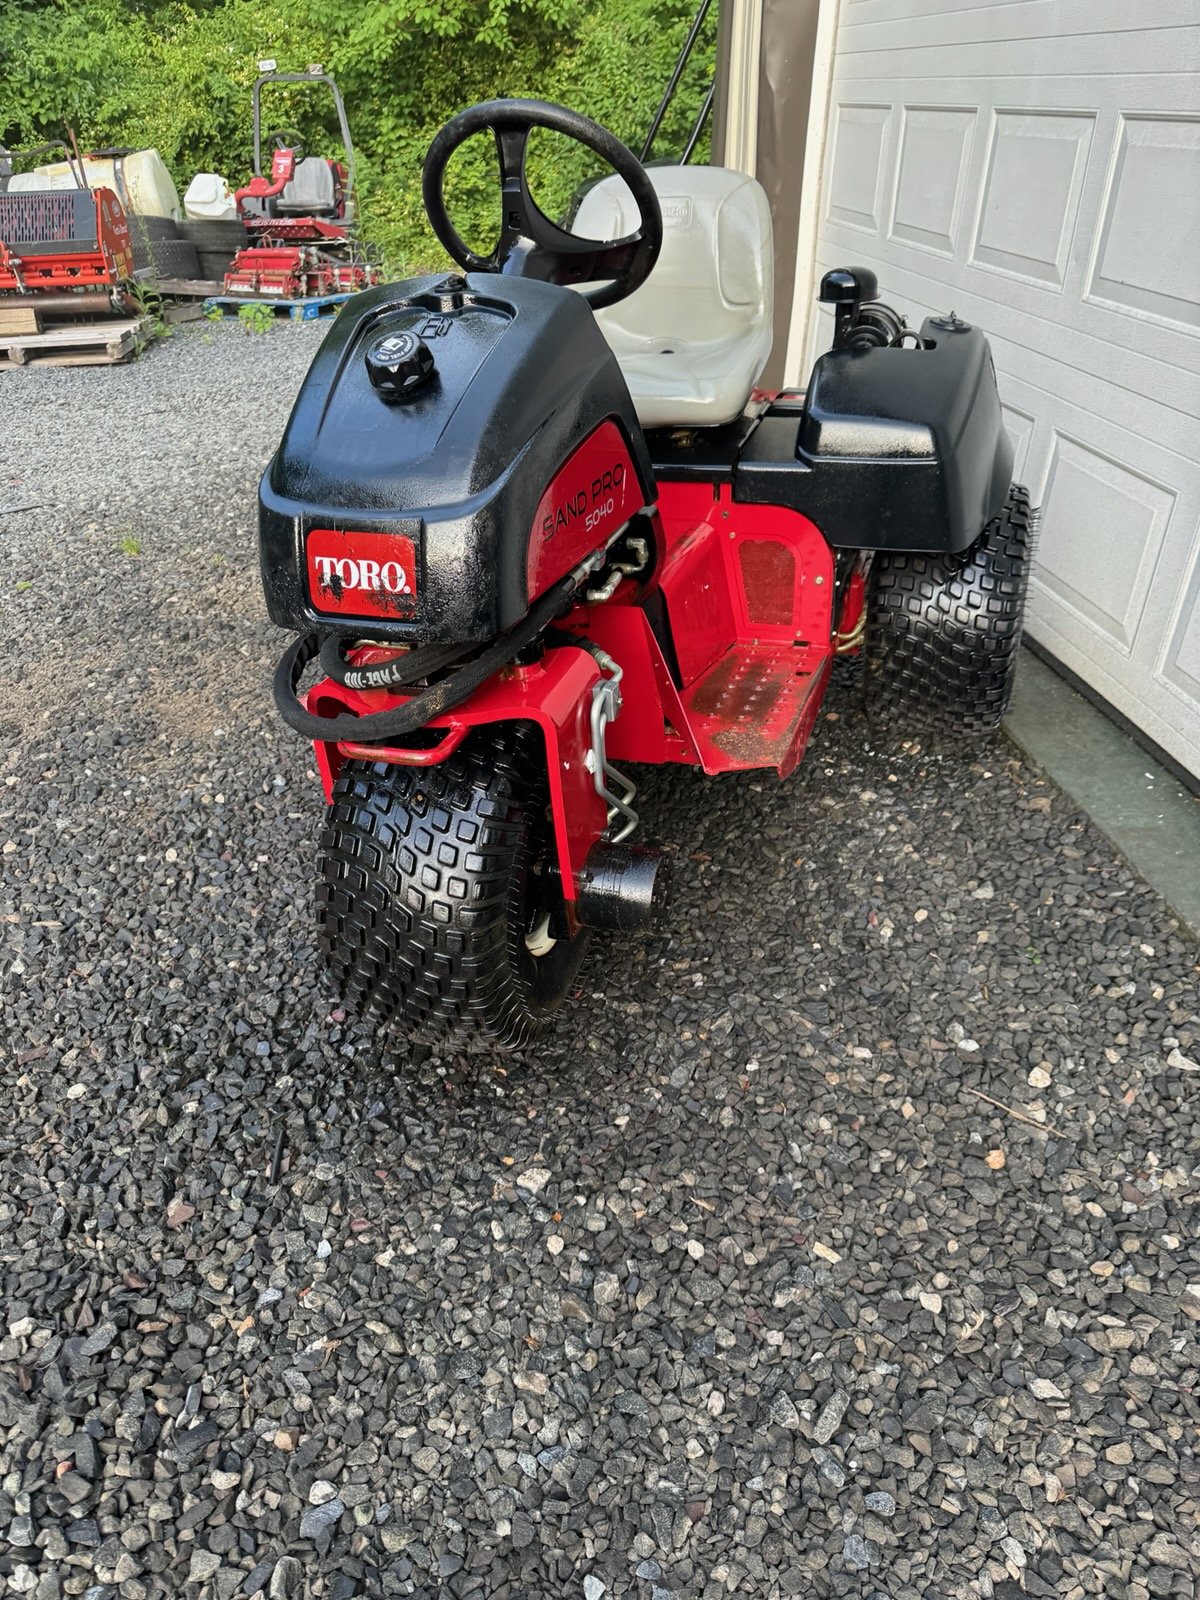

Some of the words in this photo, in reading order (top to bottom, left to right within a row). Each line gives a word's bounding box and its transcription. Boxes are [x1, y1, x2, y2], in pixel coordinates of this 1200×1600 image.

[542, 490, 588, 543] SAND
[591, 463, 624, 504] PRO
[585, 497, 615, 532] 5040
